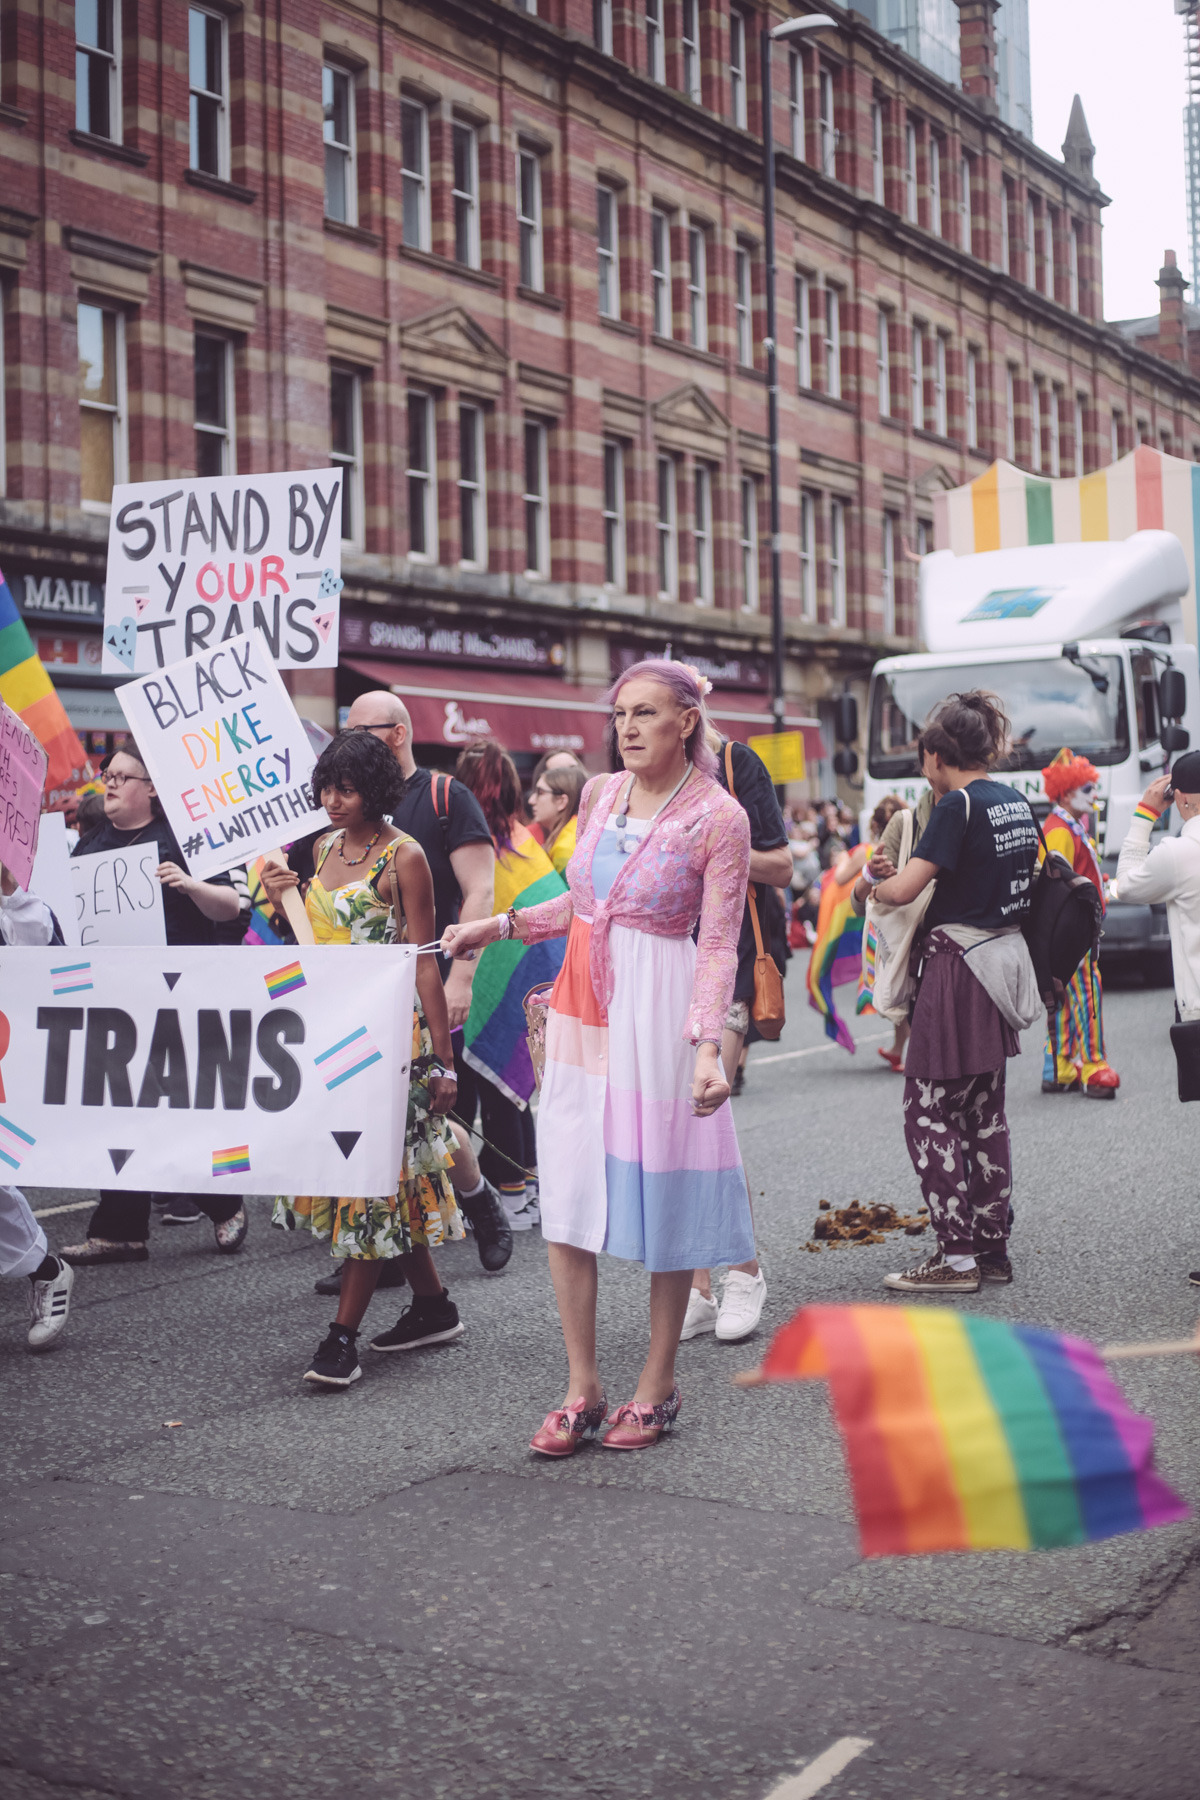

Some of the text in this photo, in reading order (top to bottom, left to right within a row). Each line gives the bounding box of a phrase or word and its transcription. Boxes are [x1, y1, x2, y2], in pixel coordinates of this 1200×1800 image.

[116, 481, 340, 561] STAND BY
[23, 574, 97, 615] MAIL
[158, 554, 290, 613] YOUR
[136, 594, 319, 668] TRANS
[142, 641, 267, 729] BLACK
[181, 702, 273, 770] DYKE
[181, 748, 290, 822] ENERGY
[993, 830, 1012, 843] Text
[995, 843, 1004, 852] to
[36, 1006, 306, 1113] TRANS
